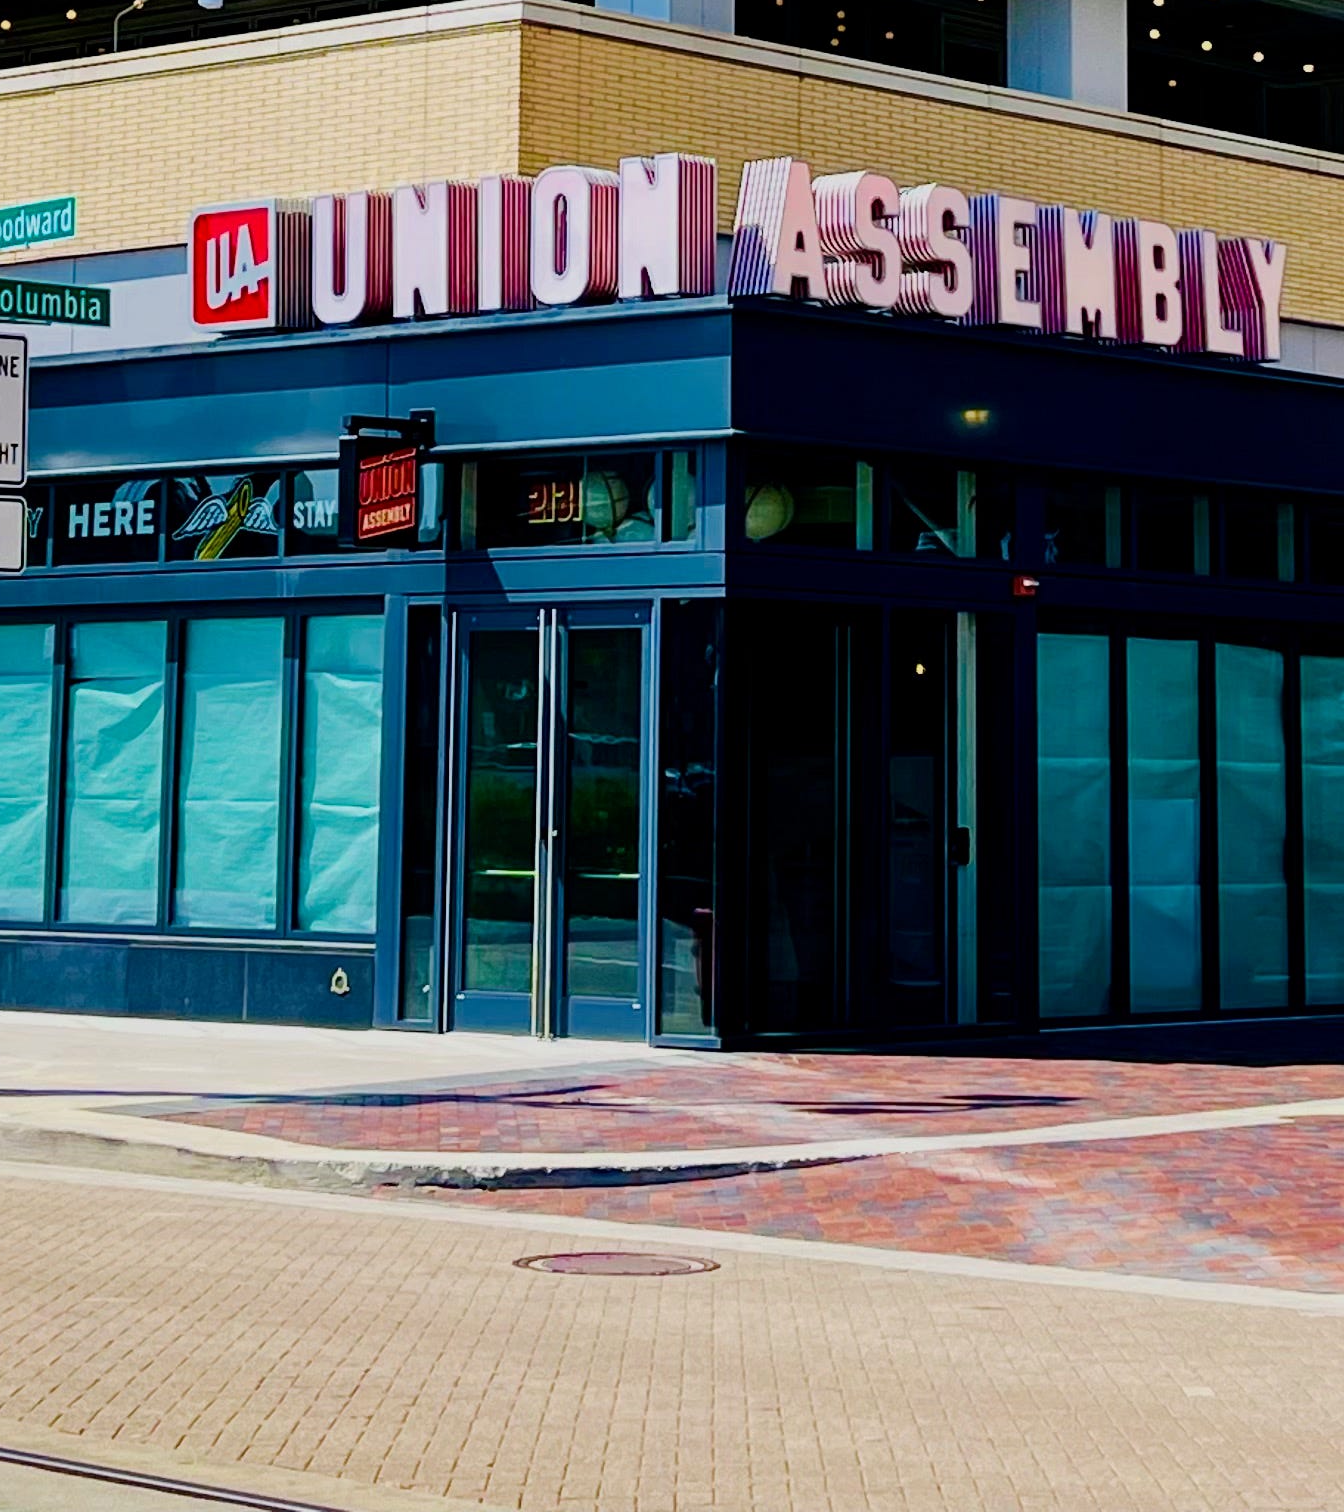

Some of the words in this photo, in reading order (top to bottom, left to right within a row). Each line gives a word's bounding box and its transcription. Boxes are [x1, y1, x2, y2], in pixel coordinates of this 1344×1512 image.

[312, 152, 684, 325] UNION
[768, 157, 1288, 362] ASSEMBLY
[359, 459, 416, 506] UNION
[67, 499, 155, 539] HERE
[293, 499, 337, 529] STAY
[362, 503, 411, 531] ASSEMBLY
